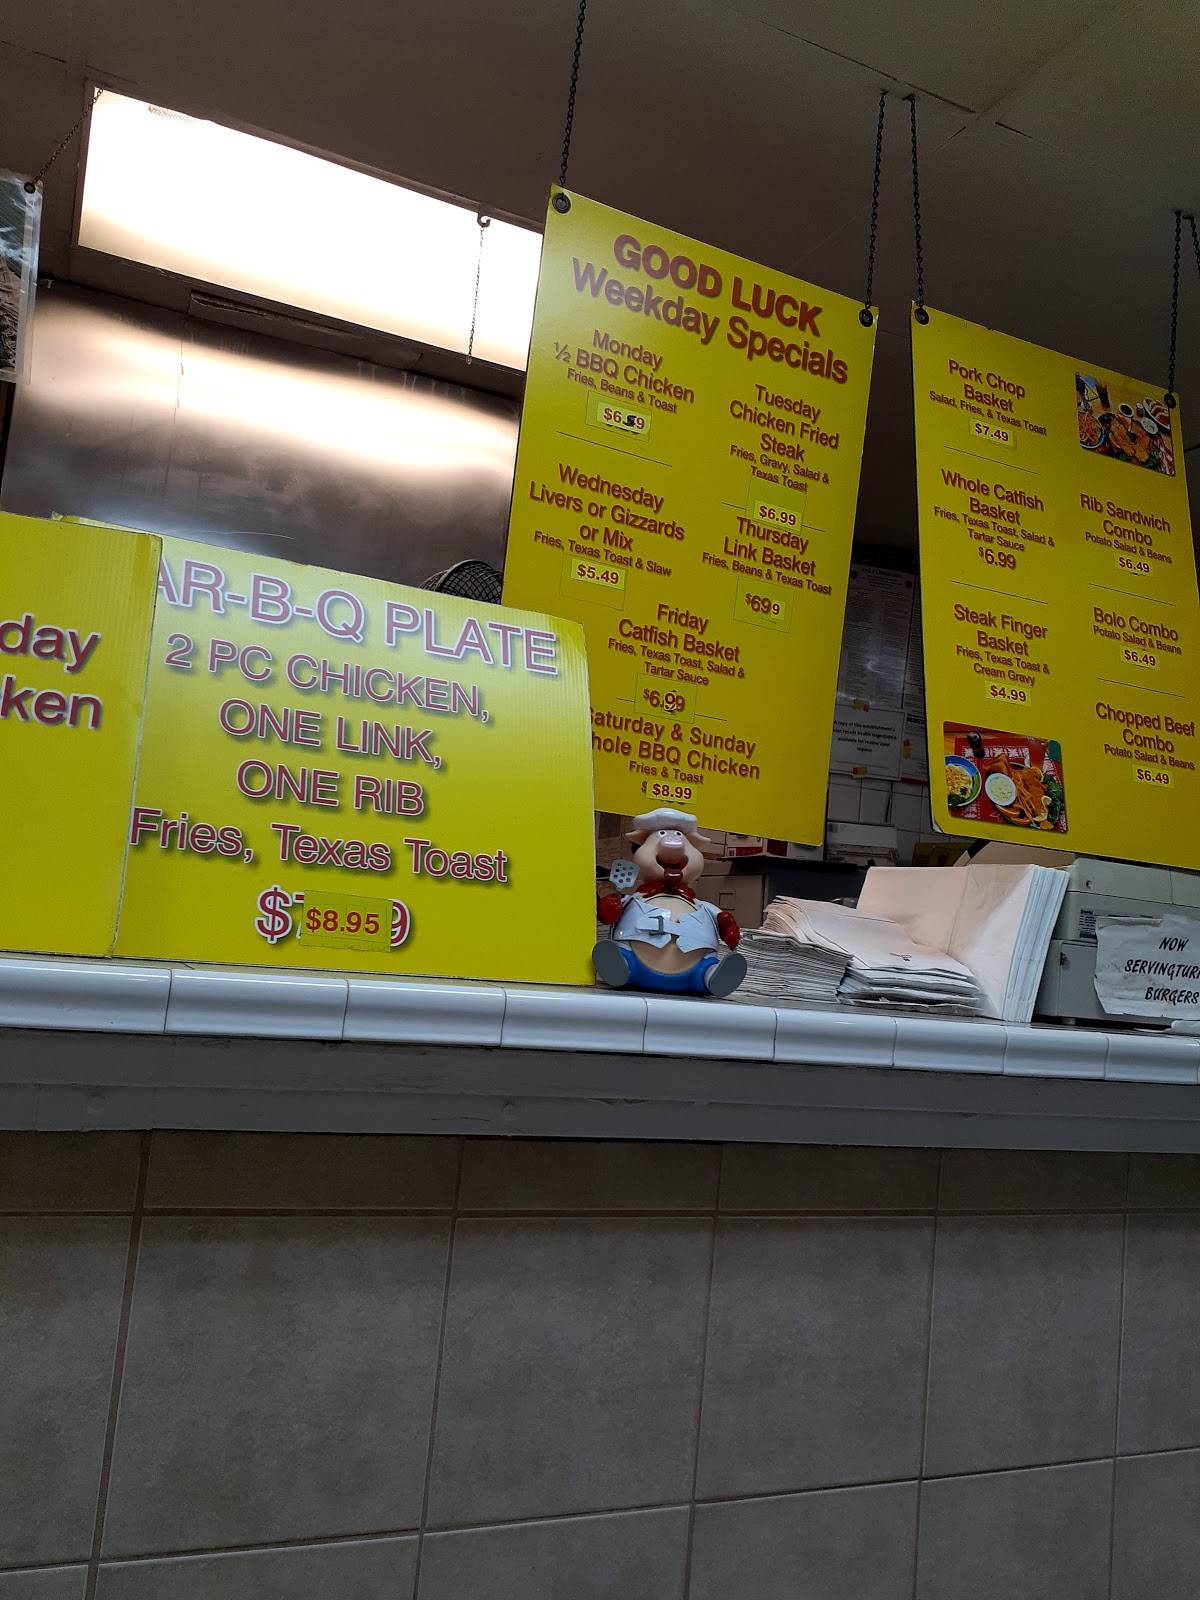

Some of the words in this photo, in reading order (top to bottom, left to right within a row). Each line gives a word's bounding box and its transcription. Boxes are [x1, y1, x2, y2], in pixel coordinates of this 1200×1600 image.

[614, 234, 723, 298] GOOD
[731, 276, 823, 337] LUCK
[572, 257, 720, 345] Weekday
[727, 315, 849, 385] Specials
[593, 329, 663, 372] Monday
[567, 368, 597, 390] Fries,
[600, 378, 634, 402] Beans
[637, 391, 646, 403] &
[649, 393, 678, 415] Toast
[576, 349, 619, 380] BBQ
[623, 361, 695, 403] Chicken
[948, 359, 984, 385] Pork
[986, 371, 1025, 400] Chop
[754, 383, 821, 424] Tuesday
[929, 390, 957, 409] Salad,
[960, 399, 985, 417] Fries,
[987, 408, 994, 419] &
[995, 409, 1021, 428] Texas
[1022, 419, 1048, 437] Toast
[963, 383, 1014, 413] Basket
[729, 399, 796, 437] Chicken
[800, 423, 839, 450] Fried
[974, 423, 1009, 442] $7.49
[730, 444, 757, 463] Fries,
[759, 452, 791, 475] Gravy,
[792, 461, 820, 482] Salad
[822, 471, 830, 484] &
[760, 433, 805, 462] Steak
[558, 463, 664, 514] Wednesday
[751, 466, 780, 484] Texas
[782, 474, 808, 493] Toast
[941, 468, 990, 497] Whole
[993, 482, 1044, 512] Catfish
[529, 480, 583, 513] Livers
[587, 500, 607, 518] or
[611, 503, 685, 541] Gizzards
[759, 504, 797, 526] $6.99
[934, 506, 960, 523] Fries,
[962, 513, 989, 530] Texas
[990, 520, 1019, 539] Toast,
[1020, 528, 1046, 545] Salad
[1047, 536, 1055, 548] &
[969, 496, 1021, 525] Basket
[1080, 493, 1103, 514] Rib
[1106, 501, 1171, 534] Sandwich
[579, 523, 599, 541] or
[603, 528, 633, 552] Mix
[736, 515, 809, 555] Thursday
[967, 528, 995, 545] Tartar
[996, 535, 1025, 552] Sauce
[1085, 532, 1113, 549] Potato
[1113, 539, 1137, 556] Salad
[1138, 546, 1145, 557] &
[1146, 548, 1173, 565] Beans
[1103, 519, 1153, 547] Combo
[533, 530, 564, 551] Fries,
[567, 540, 601, 561] Texas
[604, 550, 633, 569] Toast
[635, 556, 644, 570] &
[646, 559, 673, 578] Slaw
[723, 535, 757, 562] Link
[762, 547, 816, 577] Basket
[978, 546, 1016, 570] $6.99
[1119, 556, 1150, 574] $6.49
[577, 563, 620, 585] $5.49
[702, 552, 730, 572] Fries,
[732, 559, 763, 579] Beans
[765, 568, 773, 581] &
[774, 569, 804, 589] Texas
[806, 577, 832, 596] Toast
[657, 603, 709, 635] Friday
[953, 603, 997, 629] Steak
[1001, 614, 1048, 640] Finger
[1093, 606, 1126, 630] Bolo
[1128, 615, 1179, 642] Combo
[0, 613, 101, 673] day
[385, 600, 560, 677] PLATE
[618, 618, 678, 650] Catfish
[683, 634, 740, 663] Basket
[976, 630, 1029, 657] Basket
[1093, 625, 1121, 642] Potato
[1122, 632, 1146, 647] Salad
[1148, 638, 1155, 649] &
[1156, 639, 1182, 656] Beans
[608, 637, 637, 657] Fries,
[640, 645, 671, 664] Texas
[673, 652, 704, 671] Toast,
[707, 659, 736, 677] Salad
[737, 667, 745, 679] &
[644, 662, 675, 678] Tartar
[676, 669, 709, 686] Sauce
[956, 645, 982, 662] Fries,
[984, 651, 1013, 667] Texas
[1015, 658, 1041, 673] Toast
[1042, 663, 1050, 675] &
[973, 663, 1006, 680] Cream
[1007, 670, 1036, 687] Gravy
[1124, 649, 1156, 667] $6.49
[165, 631, 193, 670] 2
[208, 638, 273, 682] PC
[286, 652, 491, 723] CHICKEN,
[990, 684, 1027, 703] $4.99
[0, 674, 103, 729] ken
[219, 697, 322, 748] ONE
[335, 715, 443, 769] LINK,
[590, 708, 665, 740] aturday
[670, 723, 683, 742] &
[689, 727, 756, 759] Sunday
[1095, 702, 1161, 732] Chopped
[1165, 716, 1195, 738] Beef
[1104, 743, 1133, 760] Potato
[1134, 749, 1159, 764] Salad
[1160, 755, 1167, 766] &
[1168, 756, 1195, 771] Beans
[1122, 728, 1174, 754] Combo
[629, 760, 657, 777] Fries
[661, 766, 669, 778] &
[672, 768, 704, 784] Toast
[638, 740, 681, 765] BBQ
[687, 750, 760, 780] Chicken
[1136, 768, 1170, 785] $6.49
[236, 759, 339, 809] ONE
[353, 774, 426, 818] RIB
[652, 783, 693, 800] $8.99
[130, 806, 255, 864] Fries,
[271, 822, 392, 873] Texas
[404, 837, 509, 883] Toast
[306, 907, 379, 934] $8.95
[1159, 937, 1189, 951] NOW
[1145, 987, 1199, 1005] BURGERS
